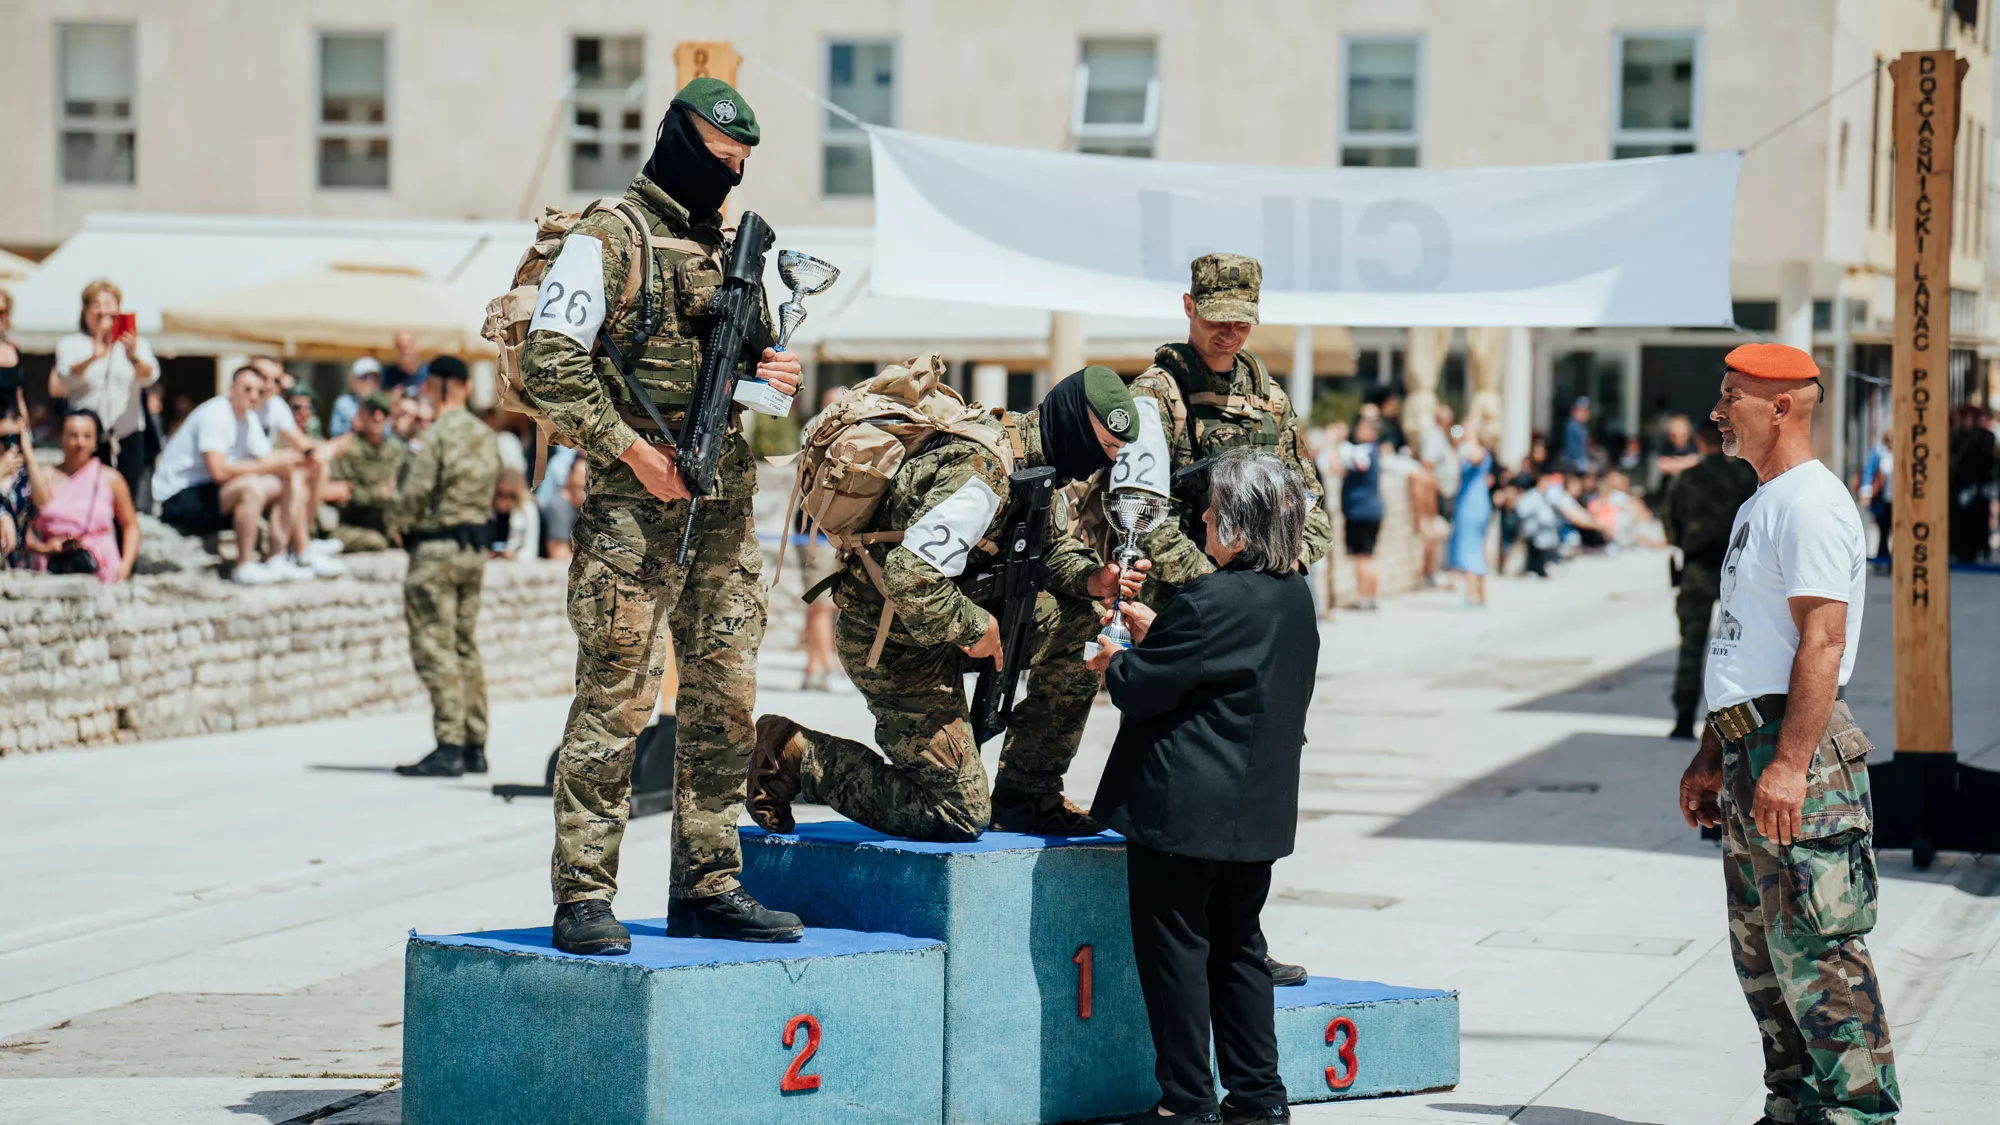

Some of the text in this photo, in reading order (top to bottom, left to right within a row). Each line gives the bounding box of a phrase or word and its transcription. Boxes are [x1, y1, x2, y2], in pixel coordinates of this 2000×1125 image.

[540, 281, 592, 327] 26
[1912, 56, 1936, 608] DOČASNIČKI LANAC POTPORE OSRH
[1113, 452, 1156, 486] 32
[918, 524, 970, 567] 27
[1073, 945, 1093, 1019] 1
[780, 1014, 821, 1092] 2
[1324, 1017, 1358, 1089] 3
